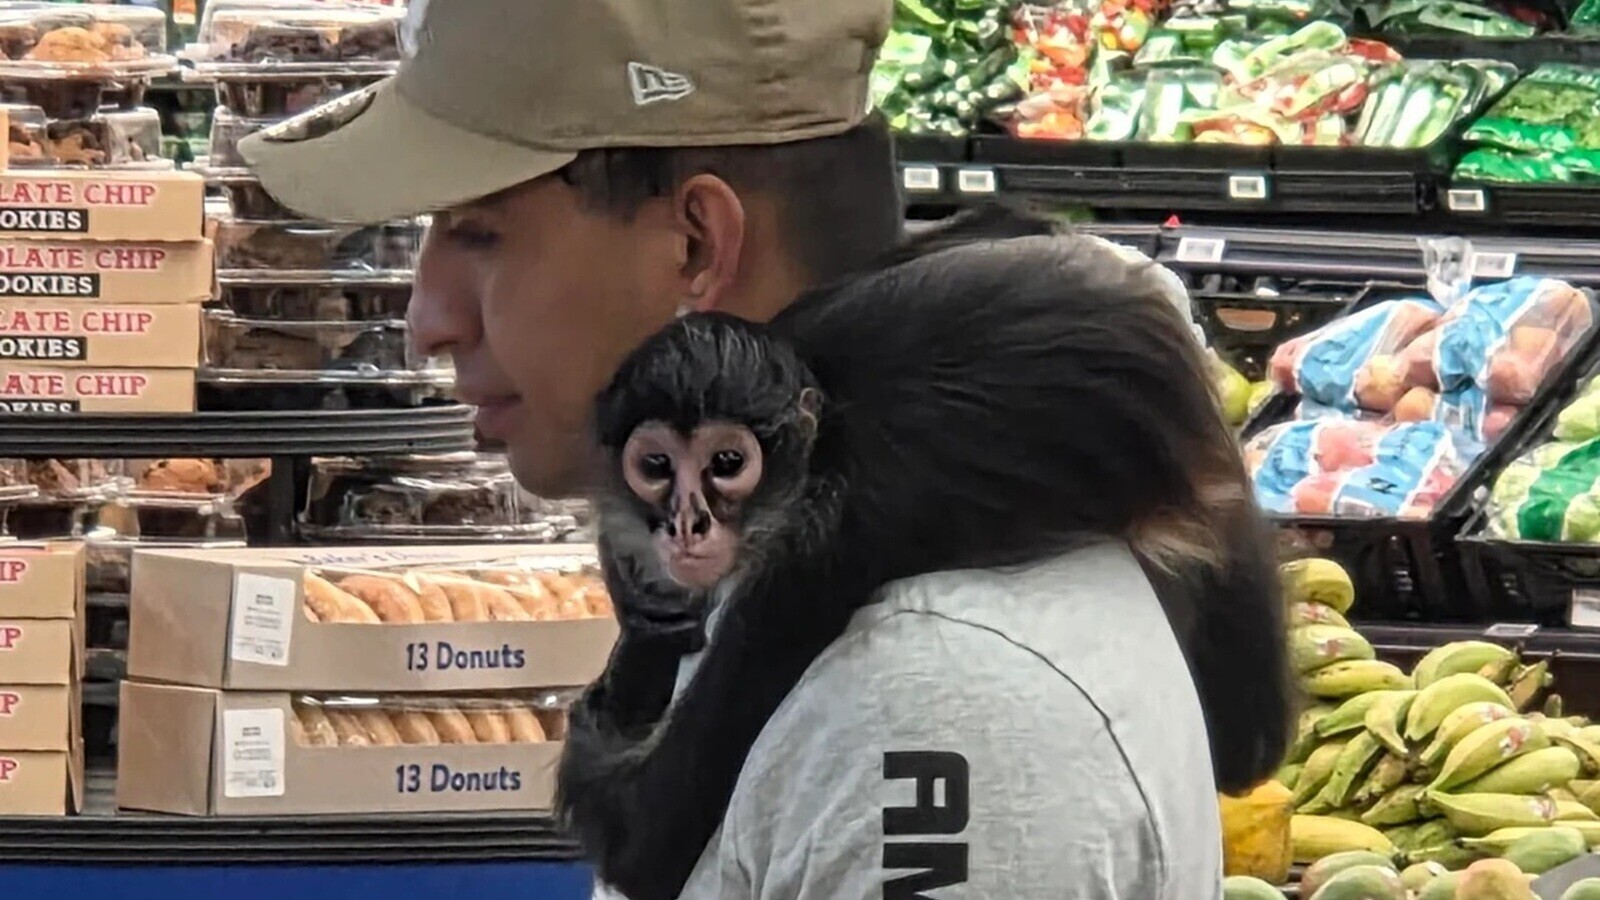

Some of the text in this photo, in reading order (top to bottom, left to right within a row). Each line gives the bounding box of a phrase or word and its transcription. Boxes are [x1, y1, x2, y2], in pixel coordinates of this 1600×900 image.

[84, 184, 156, 205] CHIP
[0, 210, 82, 230] OKIES
[0, 247, 166, 269] LATE CHIP
[82, 312, 152, 332] CHIP
[0, 374, 146, 395] ATE CHIP
[406, 641, 526, 671] 13 Donuts
[396, 763, 521, 793] 13 Donuts
